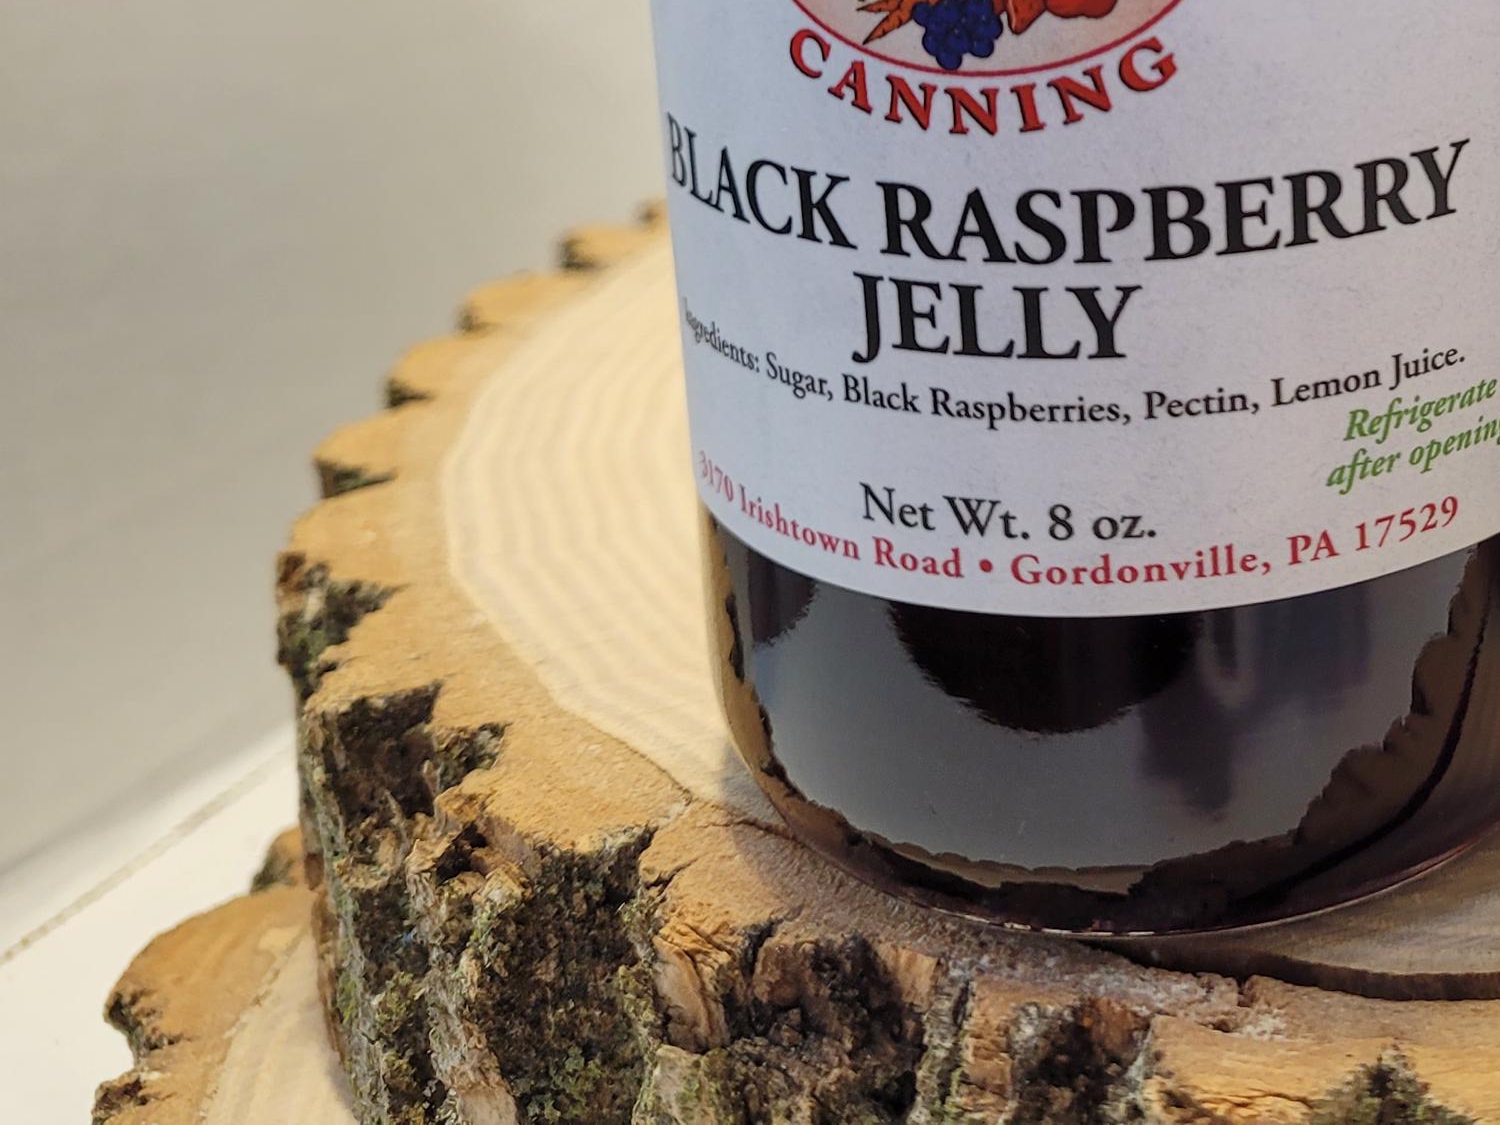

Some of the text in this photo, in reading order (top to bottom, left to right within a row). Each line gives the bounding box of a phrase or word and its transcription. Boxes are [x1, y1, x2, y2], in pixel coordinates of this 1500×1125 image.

[789, 26, 1180, 137] CANNING
[667, 111, 1472, 265] BLACK RASPBERRY
[851, 271, 1144, 364] JELLY
[765, 352, 834, 401] Sugar,
[842, 373, 922, 414] Black
[930, 387, 1132, 431] Raspberries,
[1143, 380, 1260, 423] Pectin,
[1270, 369, 1383, 407] Lemon
[1389, 347, 1466, 391] Juice.
[1343, 378, 1498, 445] Refrigerate
[858, 481, 1157, 542] Net Wt. 8 oz.
[1325, 447, 1401, 495] after
[700, 450, 1459, 587] 3170 Irishtown Road Gordonville, PA 17529
